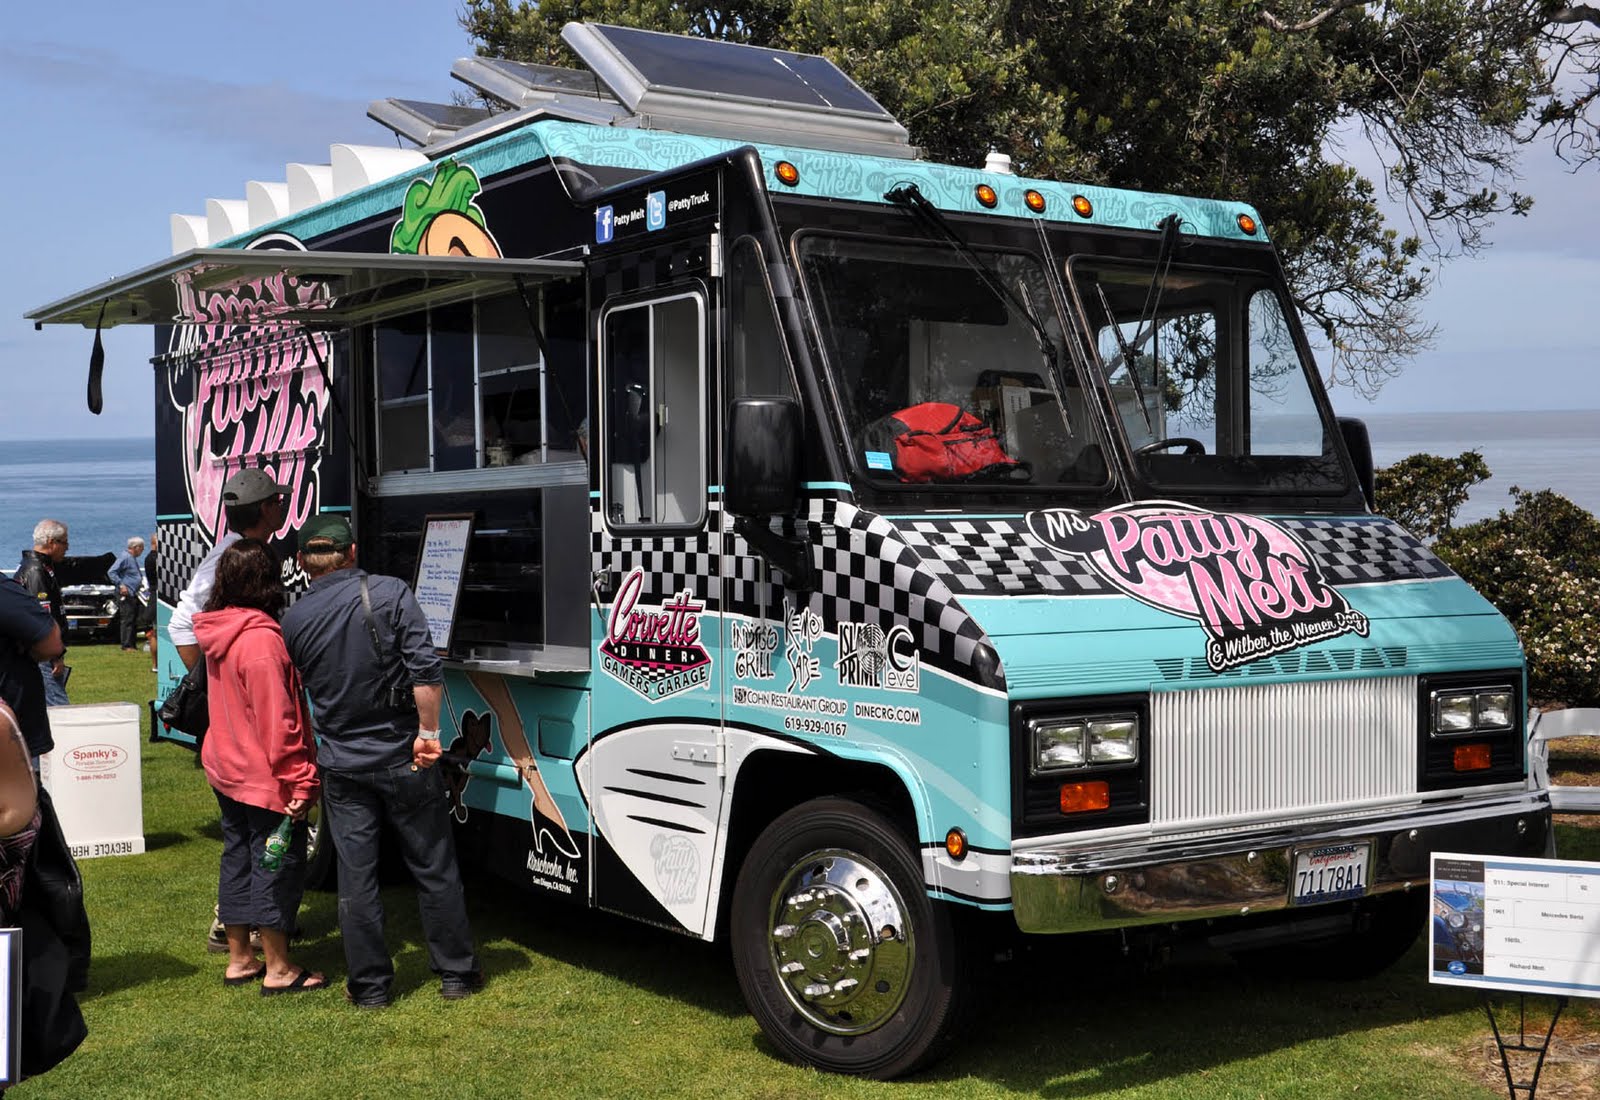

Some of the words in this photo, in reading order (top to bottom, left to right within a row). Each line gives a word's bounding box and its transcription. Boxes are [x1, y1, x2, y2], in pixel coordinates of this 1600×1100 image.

[614, 214, 630, 226] Patty
[630, 208, 645, 220] Melt
[668, 191, 710, 212] @PattyTruck
[1044, 512, 1097, 542] Ms.
[1089, 511, 1257, 580] Patty
[610, 570, 704, 646] Corvette
[1190, 555, 1333, 637] Melt
[1212, 644, 1224, 663] &
[1225, 635, 1270, 659] Wilber
[1270, 627, 1292, 645] the
[1291, 619, 1336, 639] Wiener
[1334, 611, 1362, 630] Dog
[620, 645, 688, 662] DINER
[604, 656, 650, 695] GAMERS
[657, 666, 706, 696] GARAGE
[748, 691, 769, 704] COHN
[771, 693, 818, 713] RESTAURANT
[819, 698, 847, 715] GROUP
[855, 704, 920, 723] DINECRG.COM
[785, 717, 847, 736] 619-929-0167
[73, 749, 118, 760] Spanky's
[71, 845, 90, 857] HER
[95, 842, 132, 856] RECYCLE
[1309, 852, 1355, 866] California
[1298, 863, 1363, 897] 71178A1
[1541, 911, 1568, 919] Mercedes
